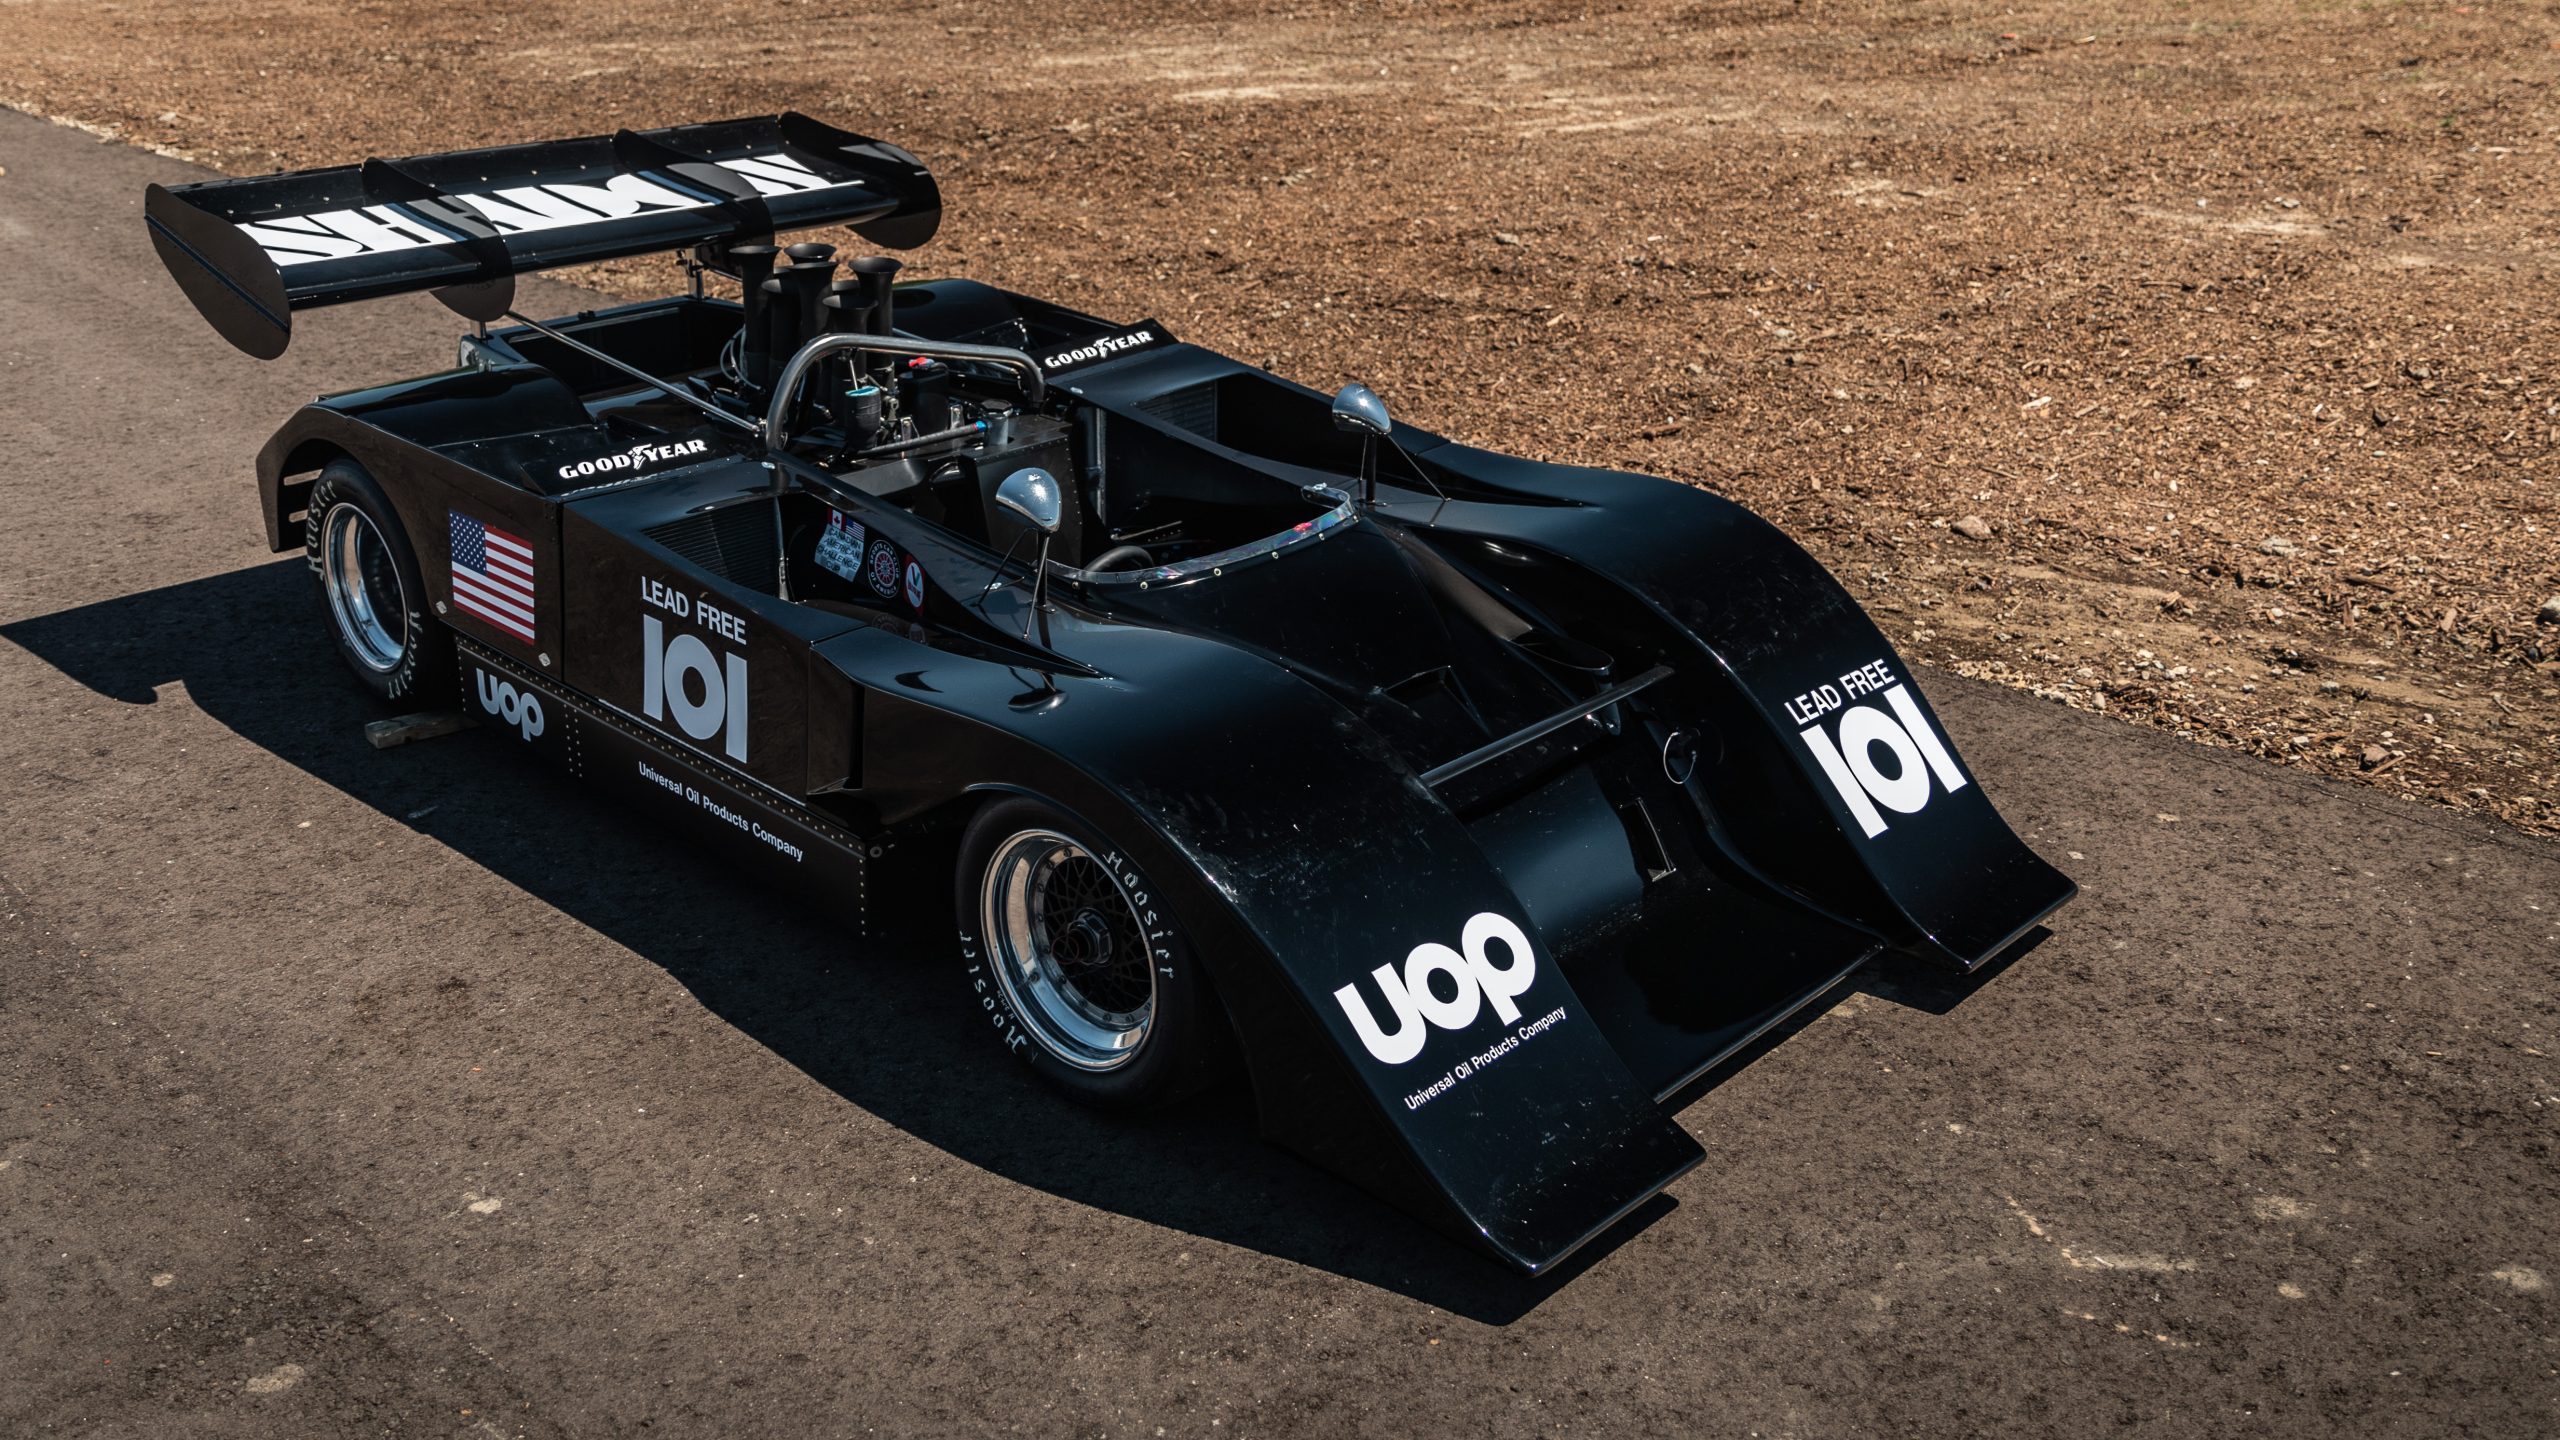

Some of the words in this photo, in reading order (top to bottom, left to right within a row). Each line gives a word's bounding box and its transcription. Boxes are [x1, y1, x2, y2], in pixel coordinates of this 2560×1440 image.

[1044, 331, 1153, 368] GOODYEAR
[558, 439, 708, 479] GOODYEAR
[824, 537, 861, 559] AMERICAN
[829, 527, 862, 549] CANADIAN
[816, 545, 859, 571] CHALLENGE
[826, 560, 841, 571] CUP
[641, 576, 689, 618] LEAD
[696, 600, 747, 646] FREE
[1784, 684, 1842, 726] LEAD
[1839, 658, 1896, 700] FREE
[638, 761, 683, 796] Universal
[686, 787, 700, 805] Oil
[703, 795, 749, 832] Products
[752, 822, 803, 863] Company
[1404, 1072, 1456, 1111] Universal
[1455, 1061, 1473, 1080] Oil
[1471, 1036, 1519, 1071] Products
[1518, 1006, 1566, 1040] Company
